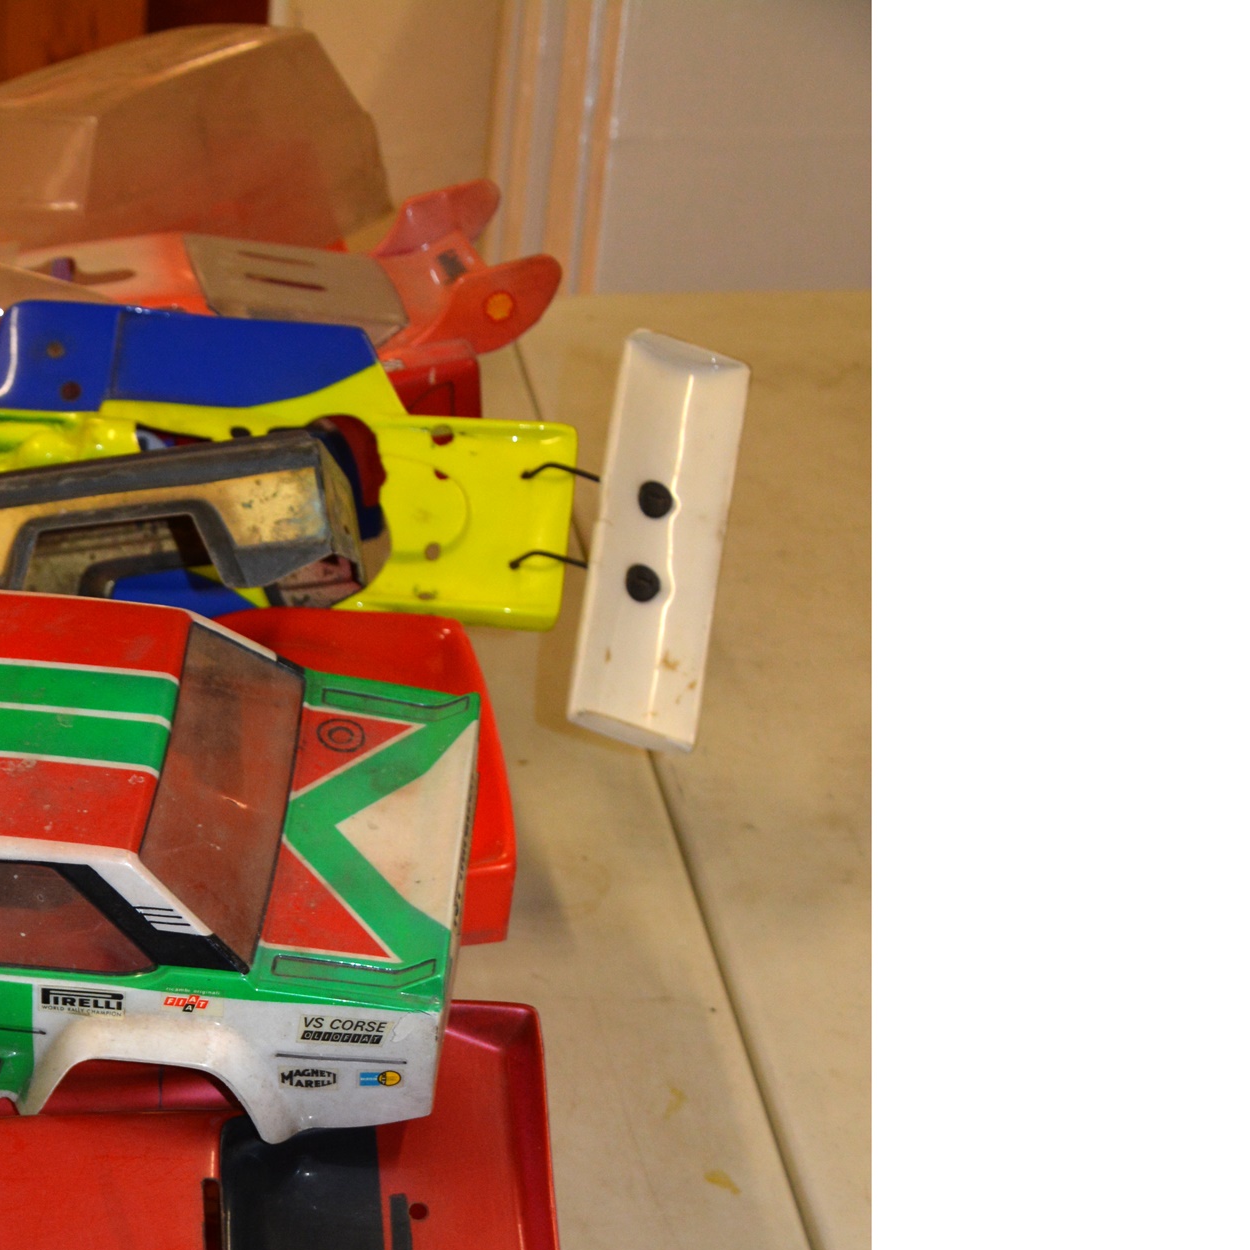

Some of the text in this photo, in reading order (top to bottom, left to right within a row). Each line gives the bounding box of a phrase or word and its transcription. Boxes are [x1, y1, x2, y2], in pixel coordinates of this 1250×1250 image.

[41, 988, 124, 1010] PIRELLI
[164, 995, 208, 1009] FIAT
[87, 1009, 122, 1017] CHAMPION
[303, 1017, 388, 1033] VS CORSE
